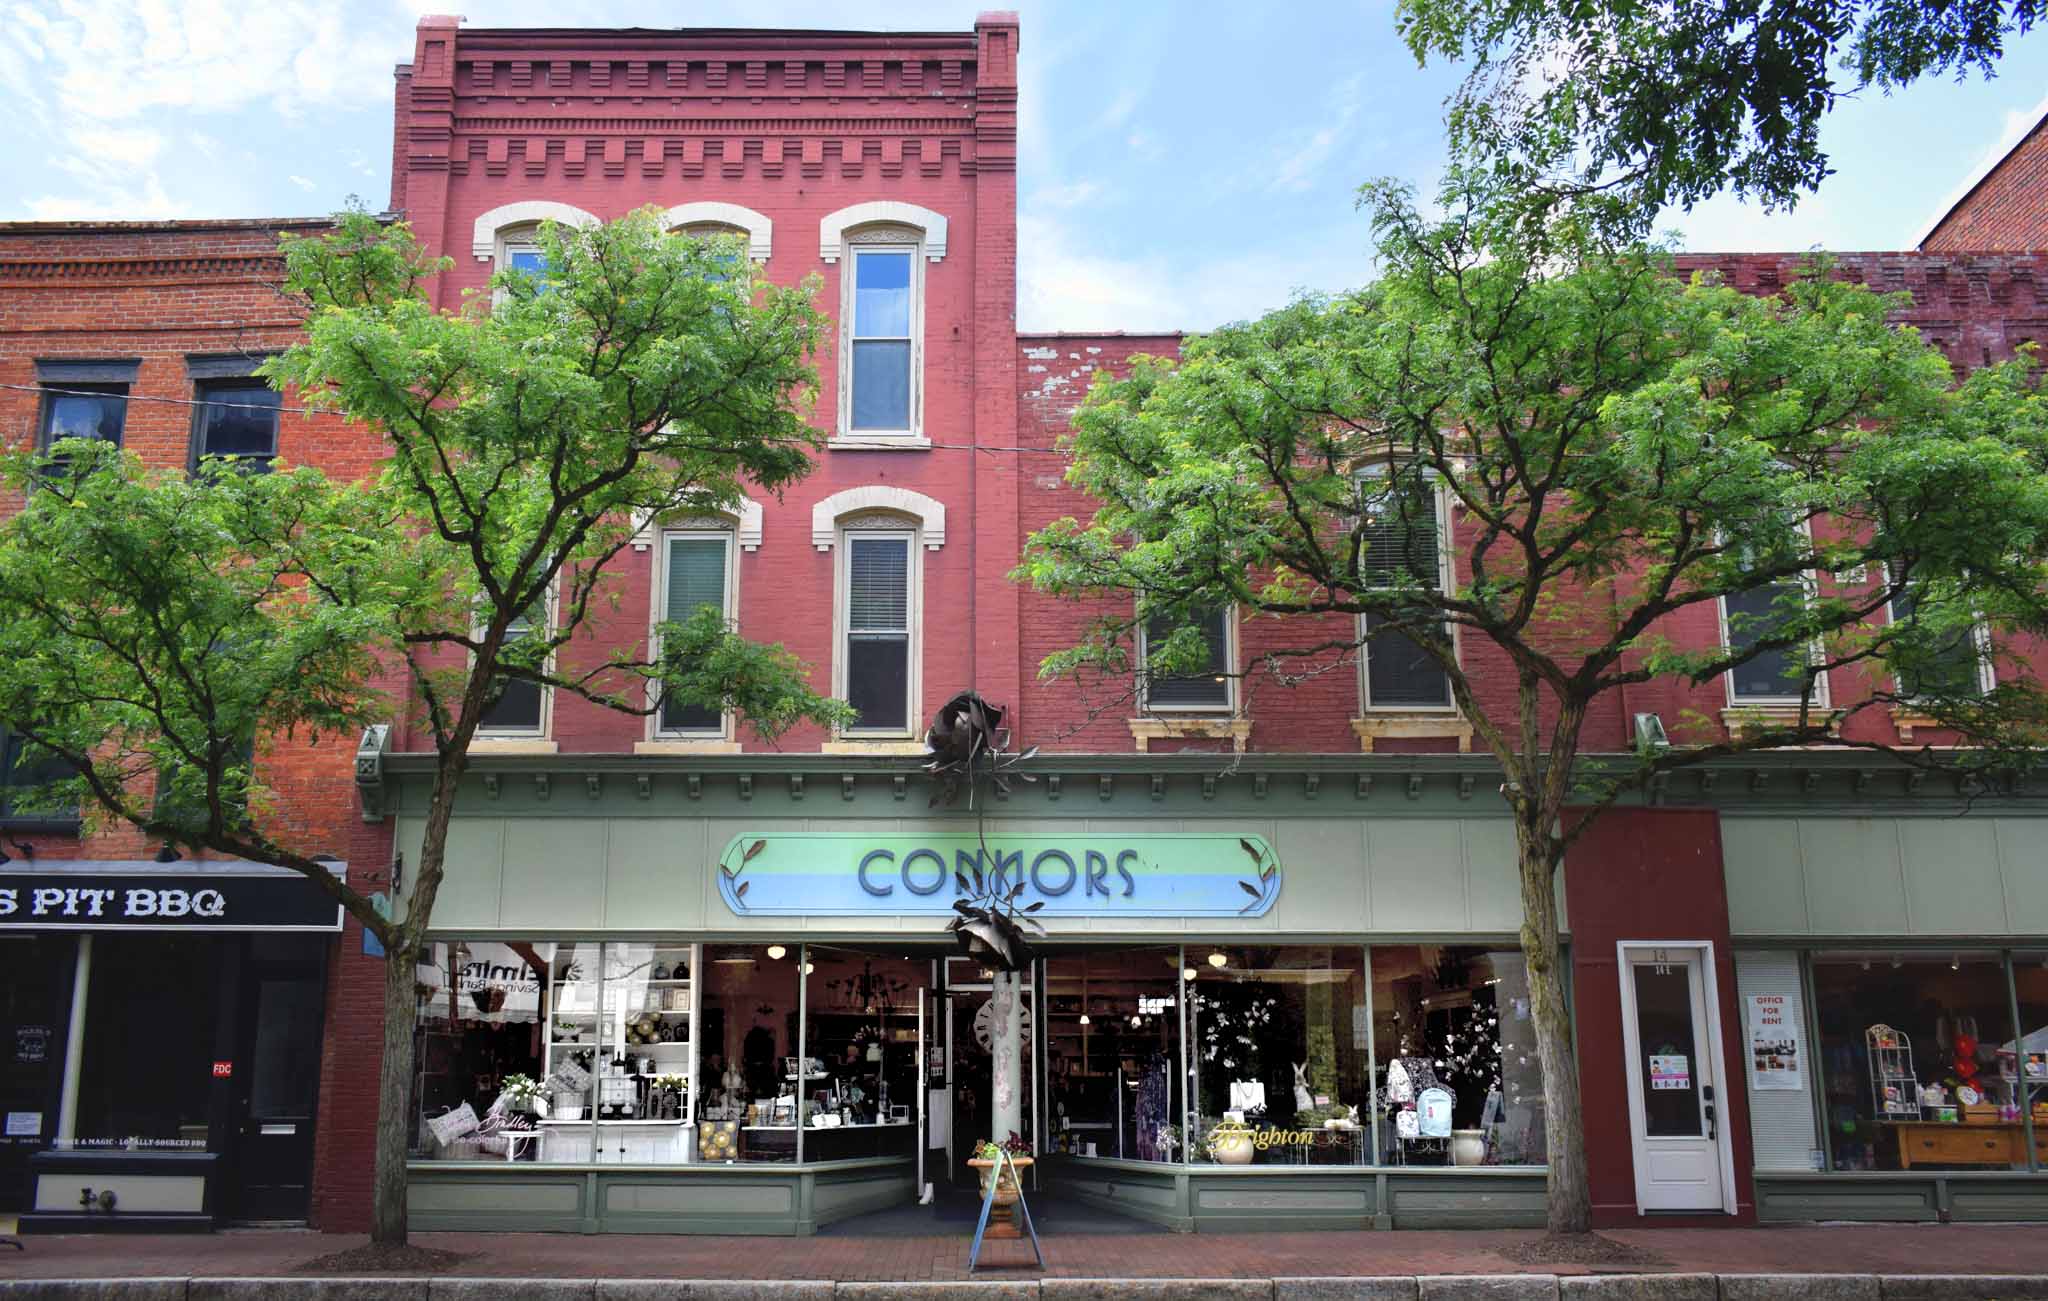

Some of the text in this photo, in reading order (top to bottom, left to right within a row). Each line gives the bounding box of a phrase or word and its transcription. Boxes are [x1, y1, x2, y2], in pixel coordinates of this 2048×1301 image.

[858, 848, 1138, 897] CONNORS
[32, 887, 115, 916] PIT
[124, 888, 226, 917] BBQ
[1756, 996, 1784, 1004] OFFICE
[1763, 1007, 1779, 1015] FOR
[213, 1064, 231, 1074] FDC
[1207, 1121, 1314, 1151] Brighton
[119, 1137, 190, 1146] LOALLY-SOURCED
